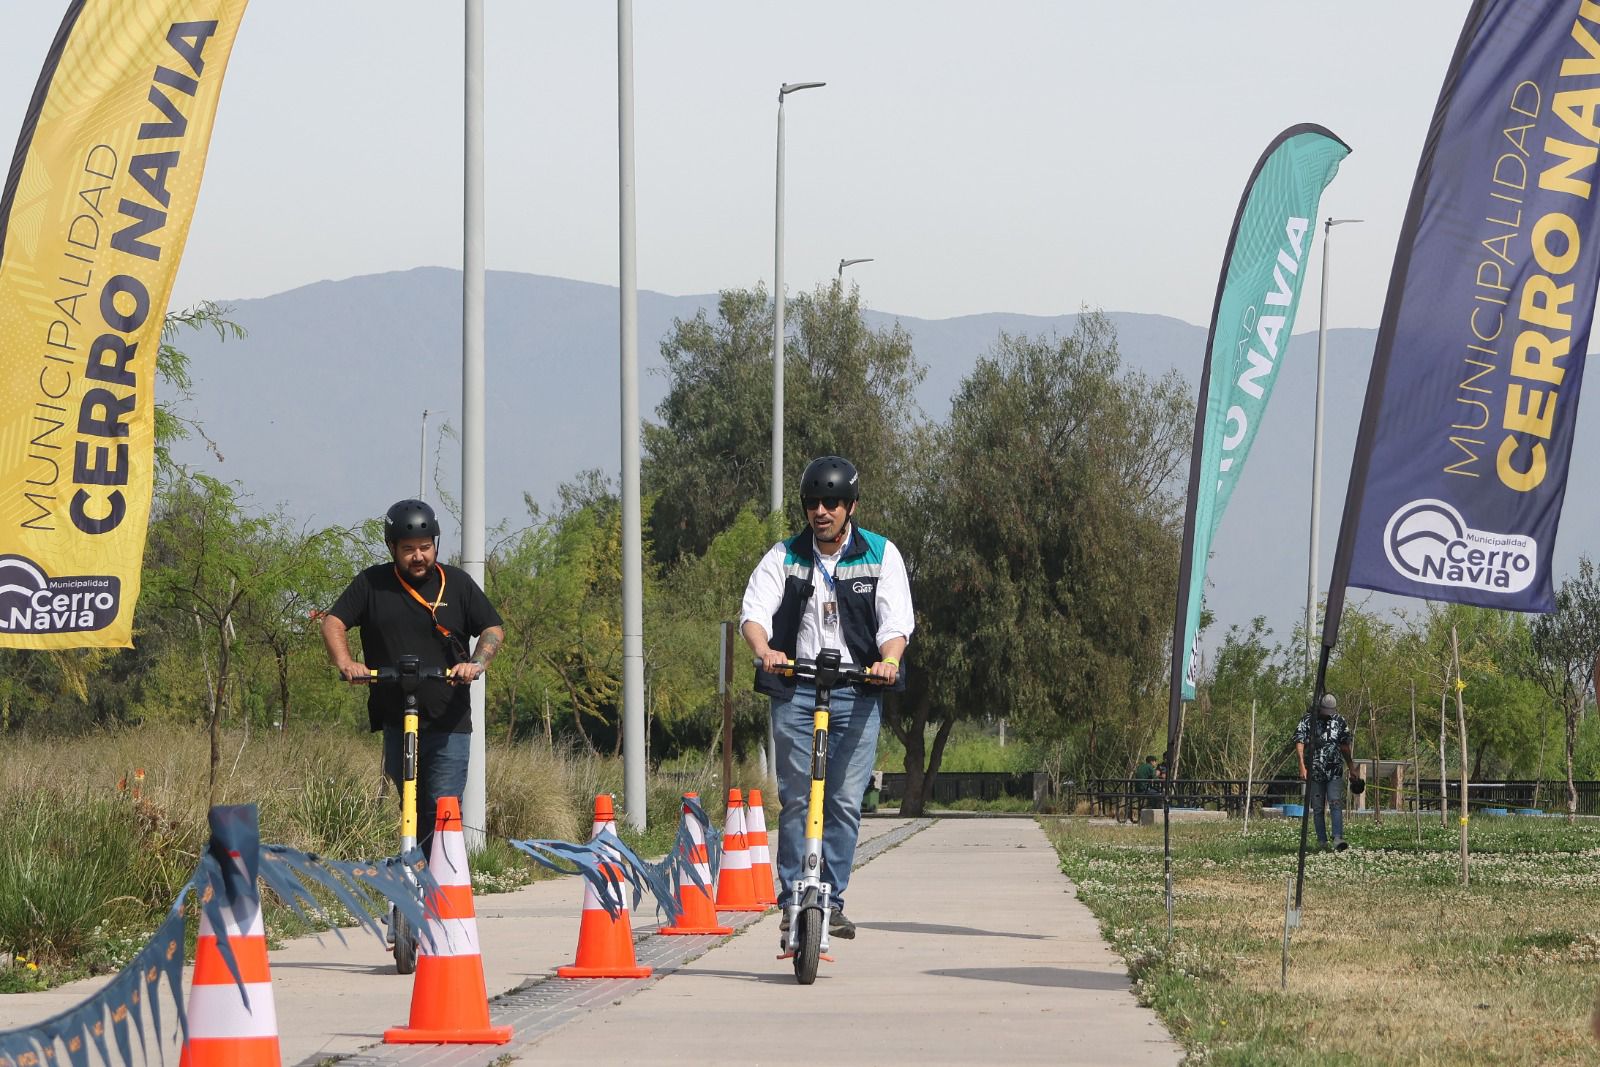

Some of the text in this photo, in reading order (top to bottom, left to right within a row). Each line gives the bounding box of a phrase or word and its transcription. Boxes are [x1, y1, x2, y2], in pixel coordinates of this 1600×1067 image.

[69, 20, 219, 534] CERRO NAVIA
[1443, 80, 1541, 477] MUNICIPALIDAD
[1237, 216, 1309, 400] NAVIA
[20, 144, 118, 530] MUNICIPALIDAD
[1496, 212, 1580, 492] CERRO
[1446, 540, 1530, 572] Cerro
[1466, 533, 1527, 548] Municipalidad
[49, 580, 109, 589] Municipalidad
[1421, 554, 1510, 588] Navia
[31, 590, 114, 612] Cerro
[9, 607, 94, 630] Navia
